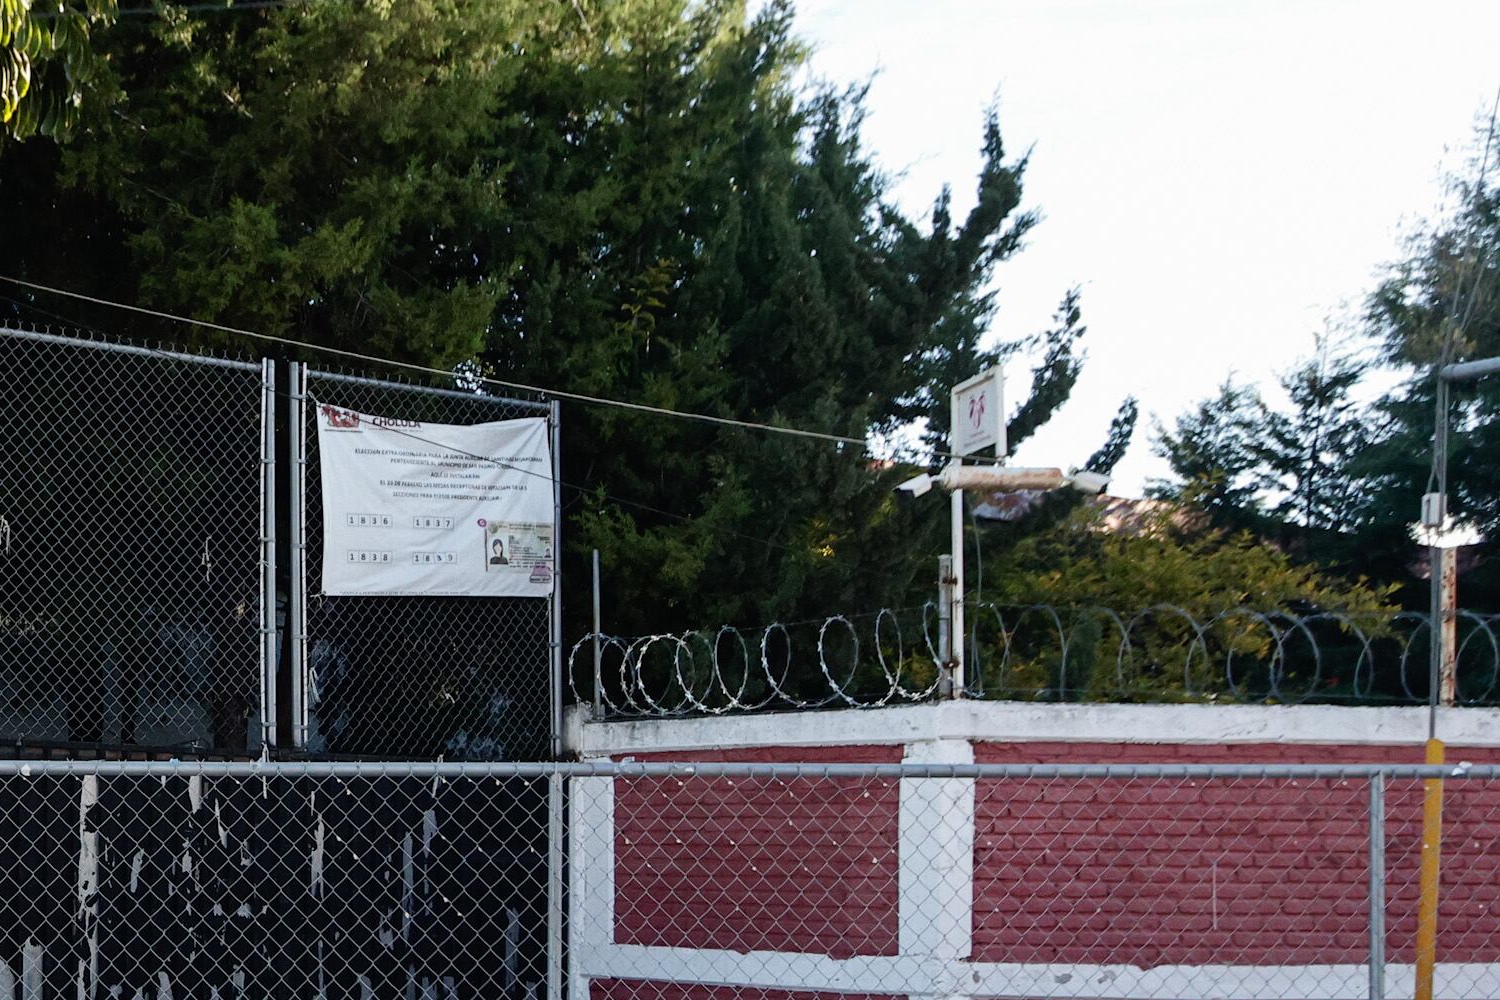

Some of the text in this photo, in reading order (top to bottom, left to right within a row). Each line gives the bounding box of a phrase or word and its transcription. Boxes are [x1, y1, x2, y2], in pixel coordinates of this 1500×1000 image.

[349, 516, 451, 527] 1836 1837
[350, 553, 388, 561] 1838
